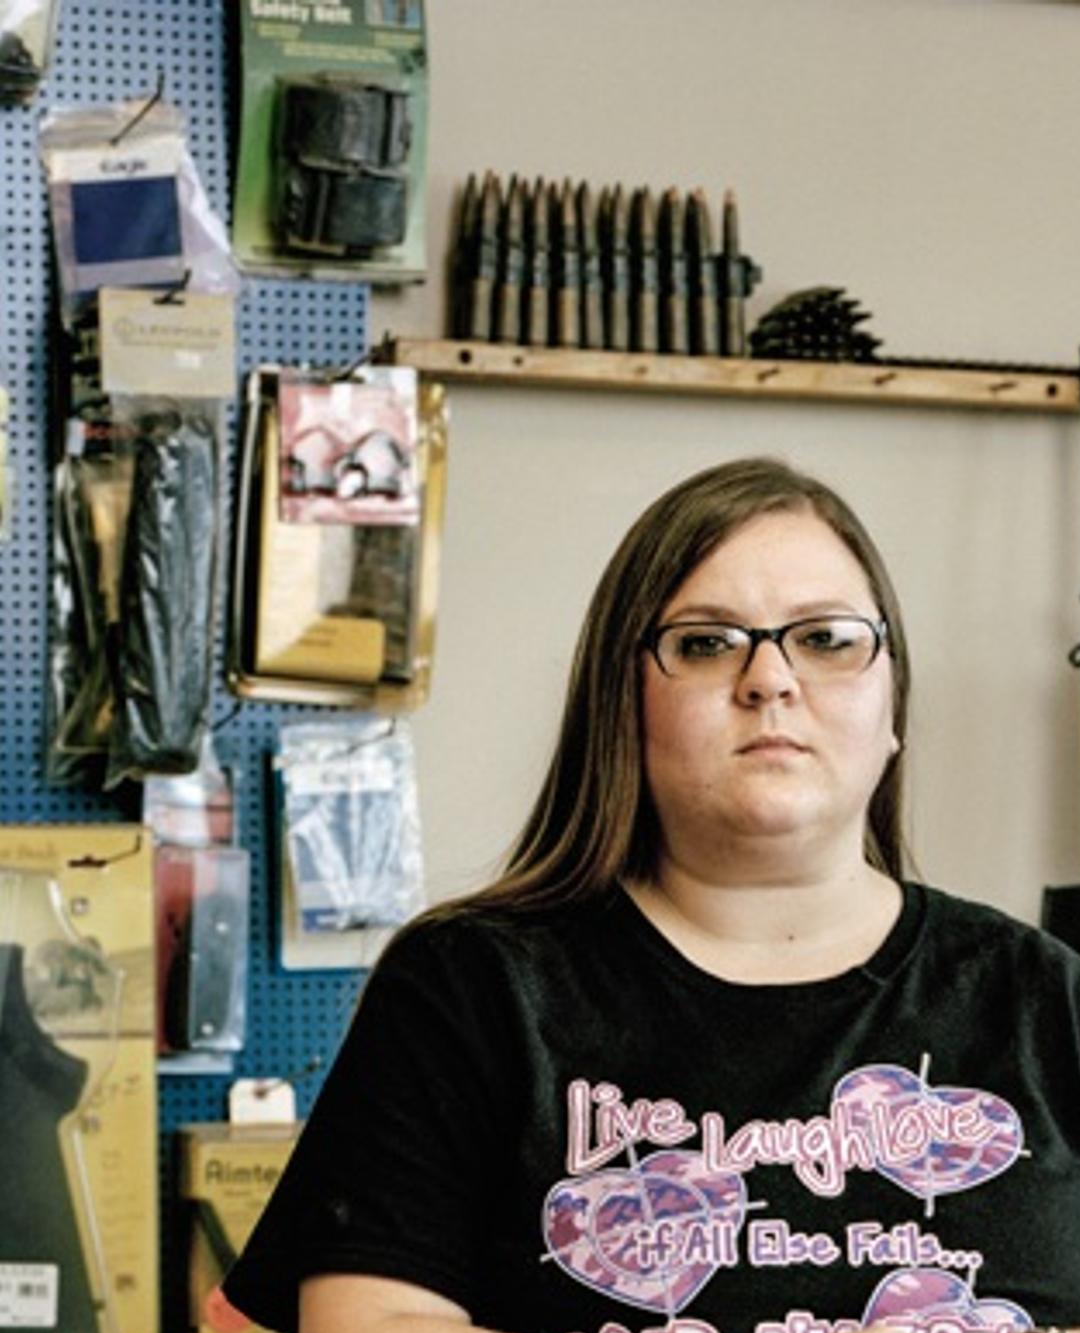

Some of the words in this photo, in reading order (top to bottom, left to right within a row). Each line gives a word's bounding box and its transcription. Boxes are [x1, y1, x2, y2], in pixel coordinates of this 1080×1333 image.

[567, 1077, 697, 1176] Live
[700, 1102, 874, 1197] Laugh
[676, 1217, 738, 1268] All
[746, 1218, 840, 1268] Else
